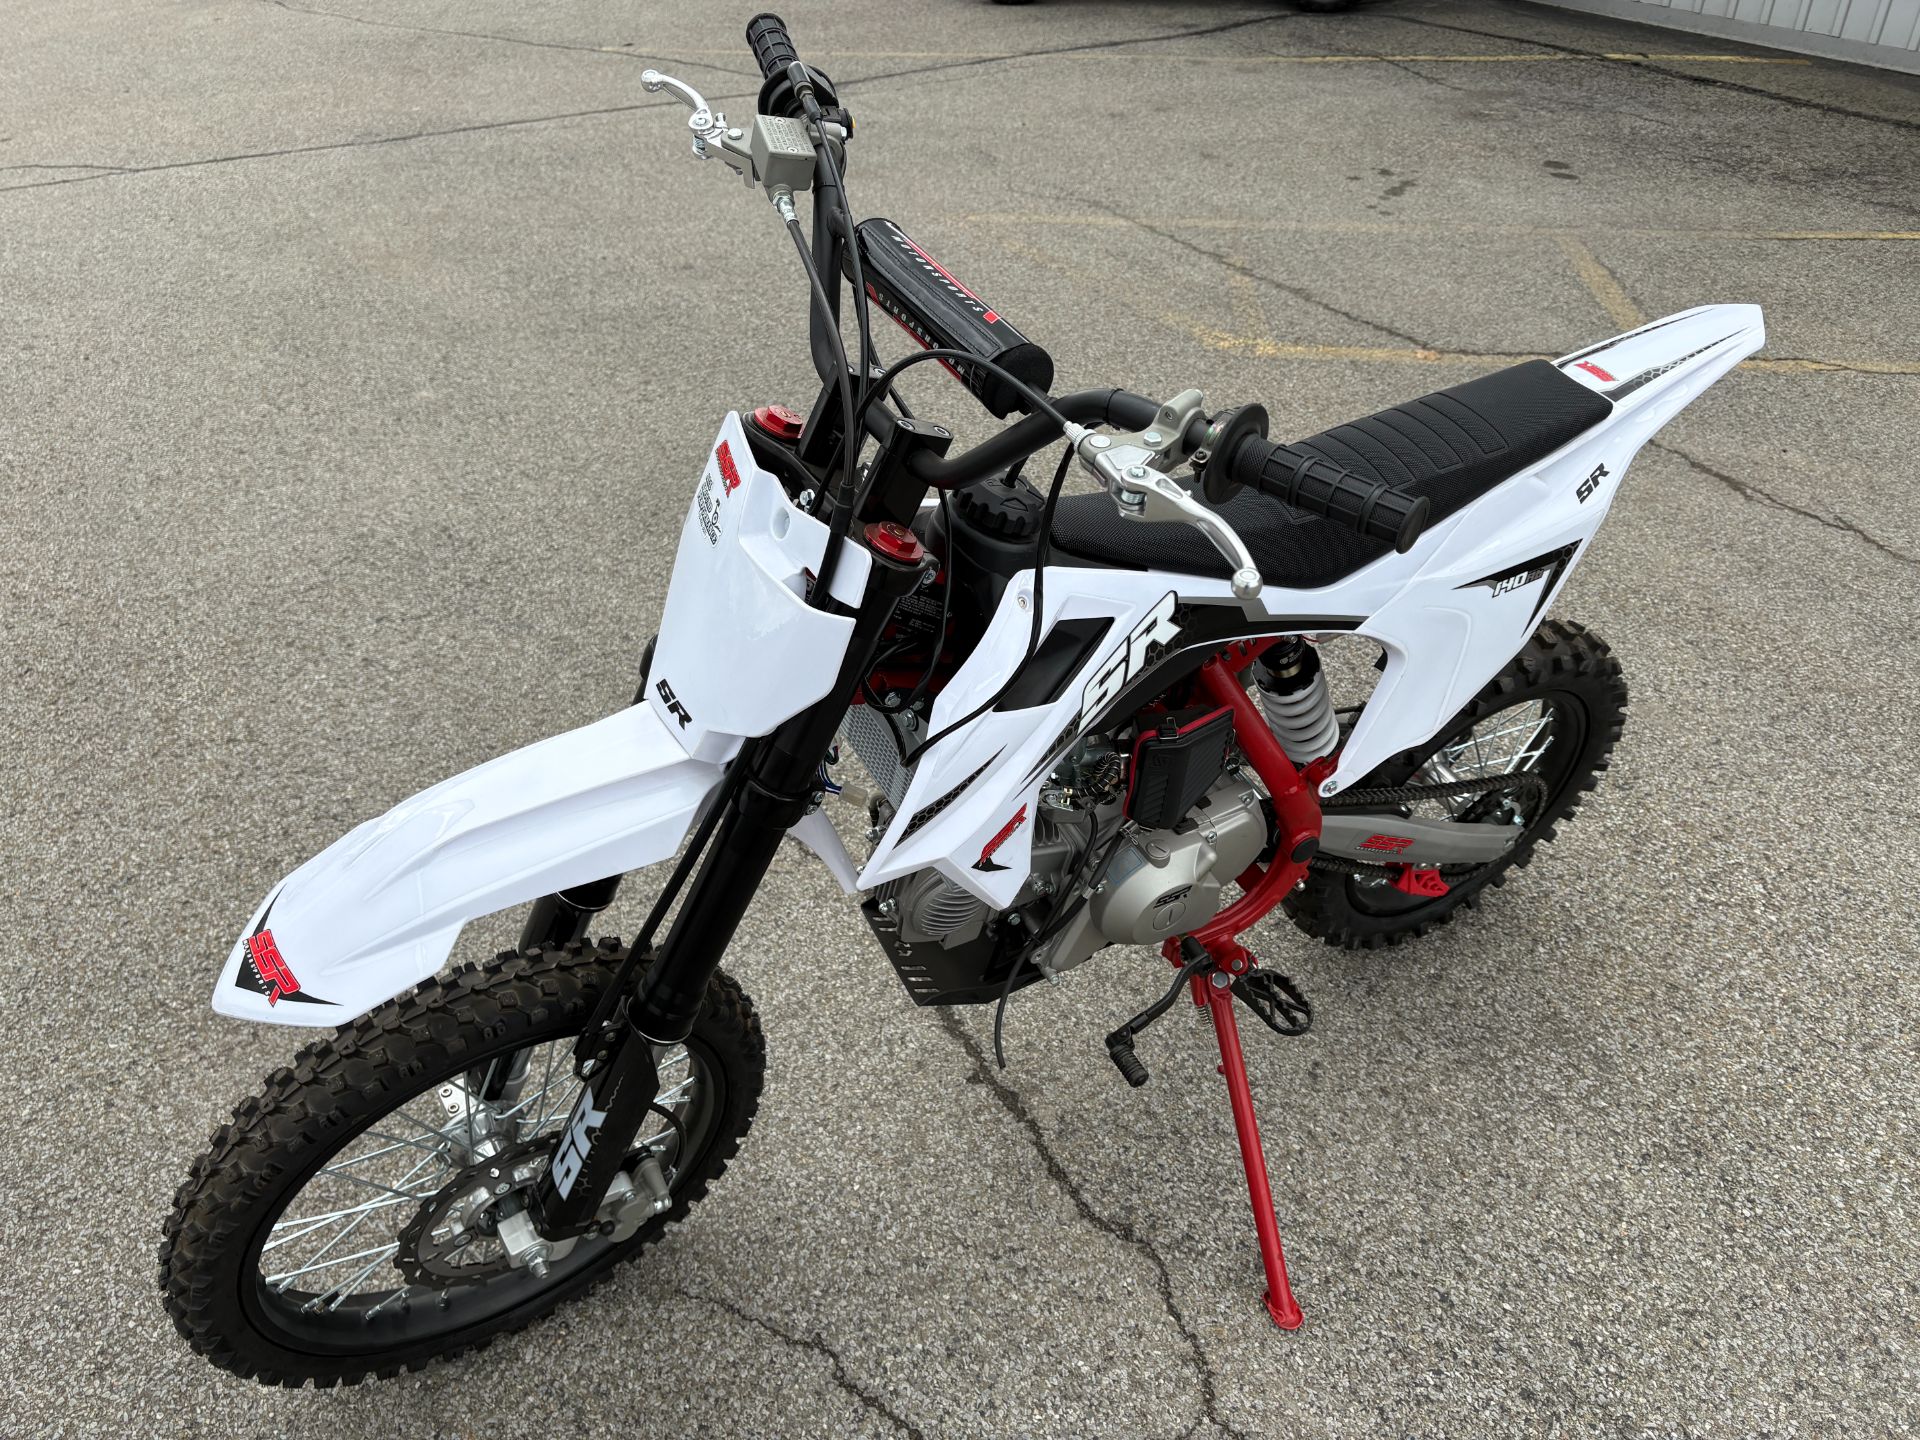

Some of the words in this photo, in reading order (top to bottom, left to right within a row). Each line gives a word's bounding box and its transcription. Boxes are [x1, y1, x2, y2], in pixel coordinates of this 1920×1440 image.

[890, 235, 984, 312] MOTORSPORTS
[878, 293, 966, 375] MOORSPORTS
[1576, 463, 1610, 504] SR
[1078, 590, 1182, 736] SR
[656, 679, 693, 731] SR
[1360, 833, 1415, 855] SSR
[1153, 885, 1193, 909] SSR
[249, 929, 301, 1008] SSR
[552, 1086, 608, 1202] SR
